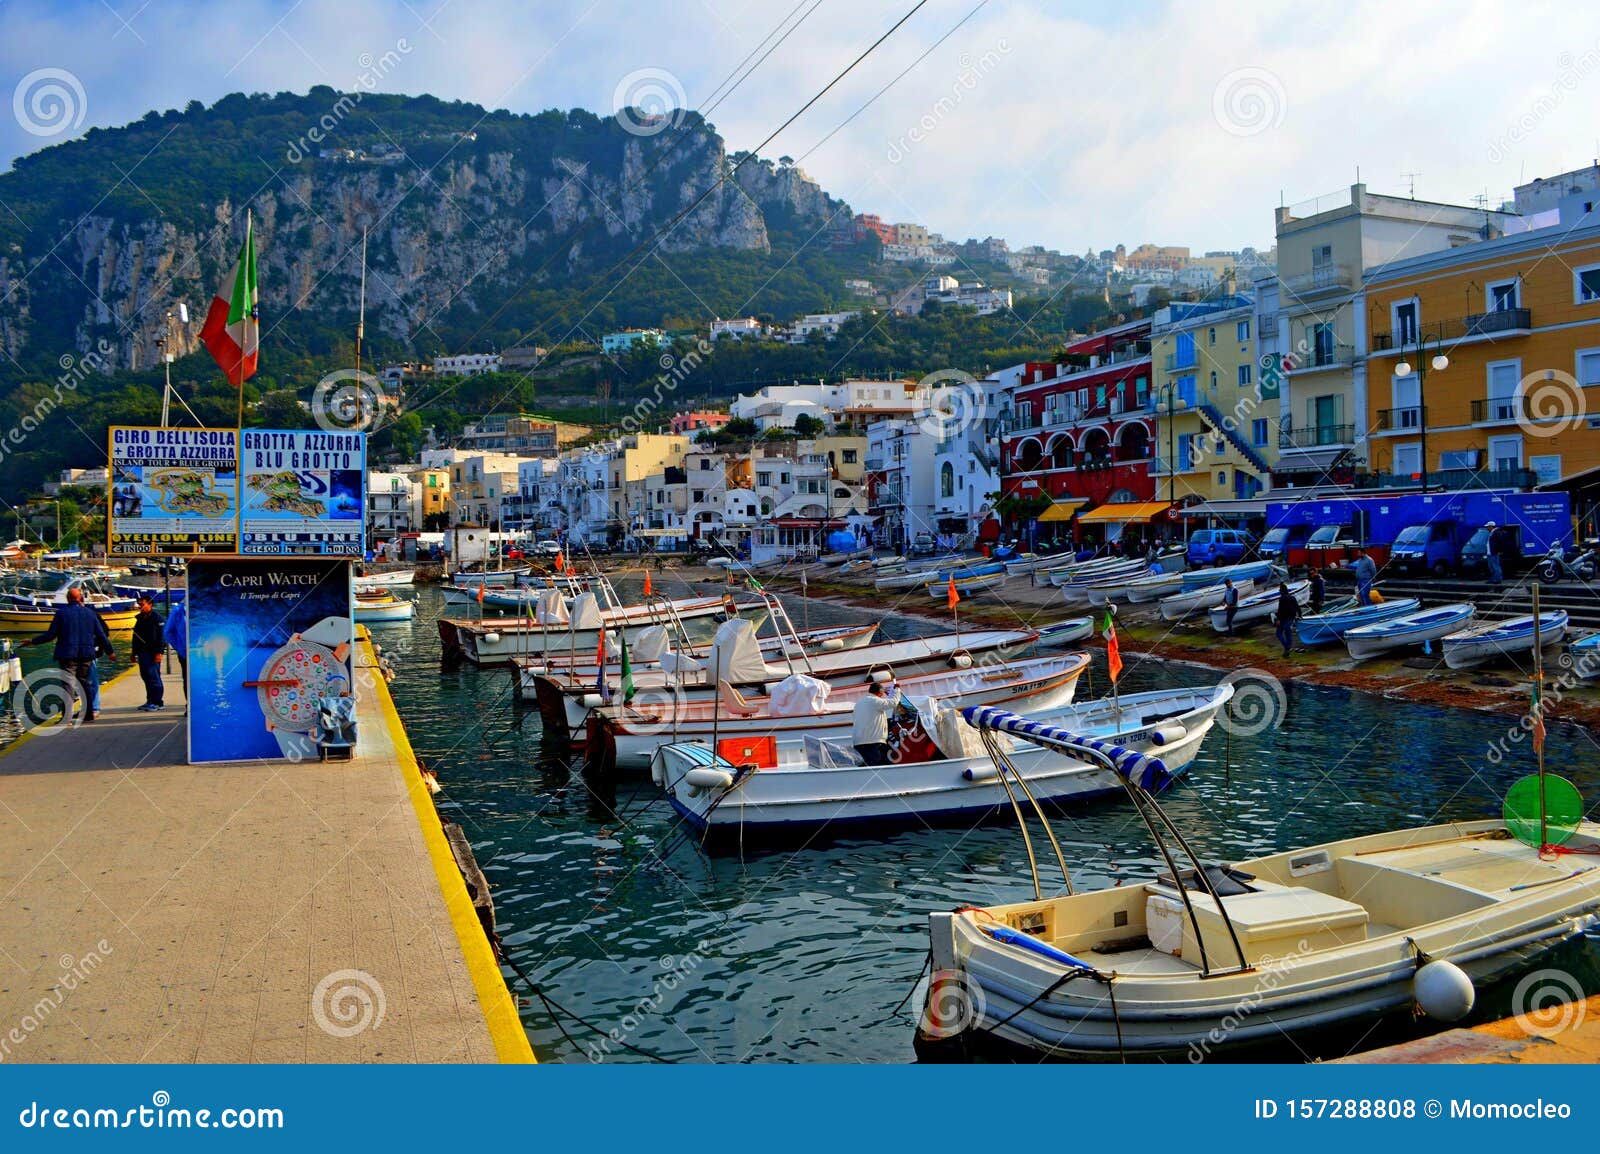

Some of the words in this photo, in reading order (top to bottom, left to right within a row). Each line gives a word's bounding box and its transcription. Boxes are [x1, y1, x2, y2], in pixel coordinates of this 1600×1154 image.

[114, 429, 150, 444] GIRO
[156, 430, 236, 446] DELL'ISOLA
[244, 432, 295, 450] GROTTA
[304, 434, 361, 452] AZZURRA
[127, 445, 177, 459] GROTTA
[180, 446, 236, 460] AZZURRA
[255, 451, 283, 468] BLU
[291, 452, 350, 469] GROTTO
[113, 459, 144, 467] ISLAND
[148, 459, 170, 467] TOUR
[201, 460, 236, 468] GROTTO
[122, 533, 189, 542] YELLOW
[199, 533, 235, 542] LINE
[254, 533, 297, 542] BLU
[309, 533, 359, 542] LINE
[220, 573, 263, 587] CAPRI
[267, 572, 318, 585] WATCH
[248, 592, 270, 601] Tempo
[271, 591, 279, 599] di
[280, 591, 301, 601] Capri
